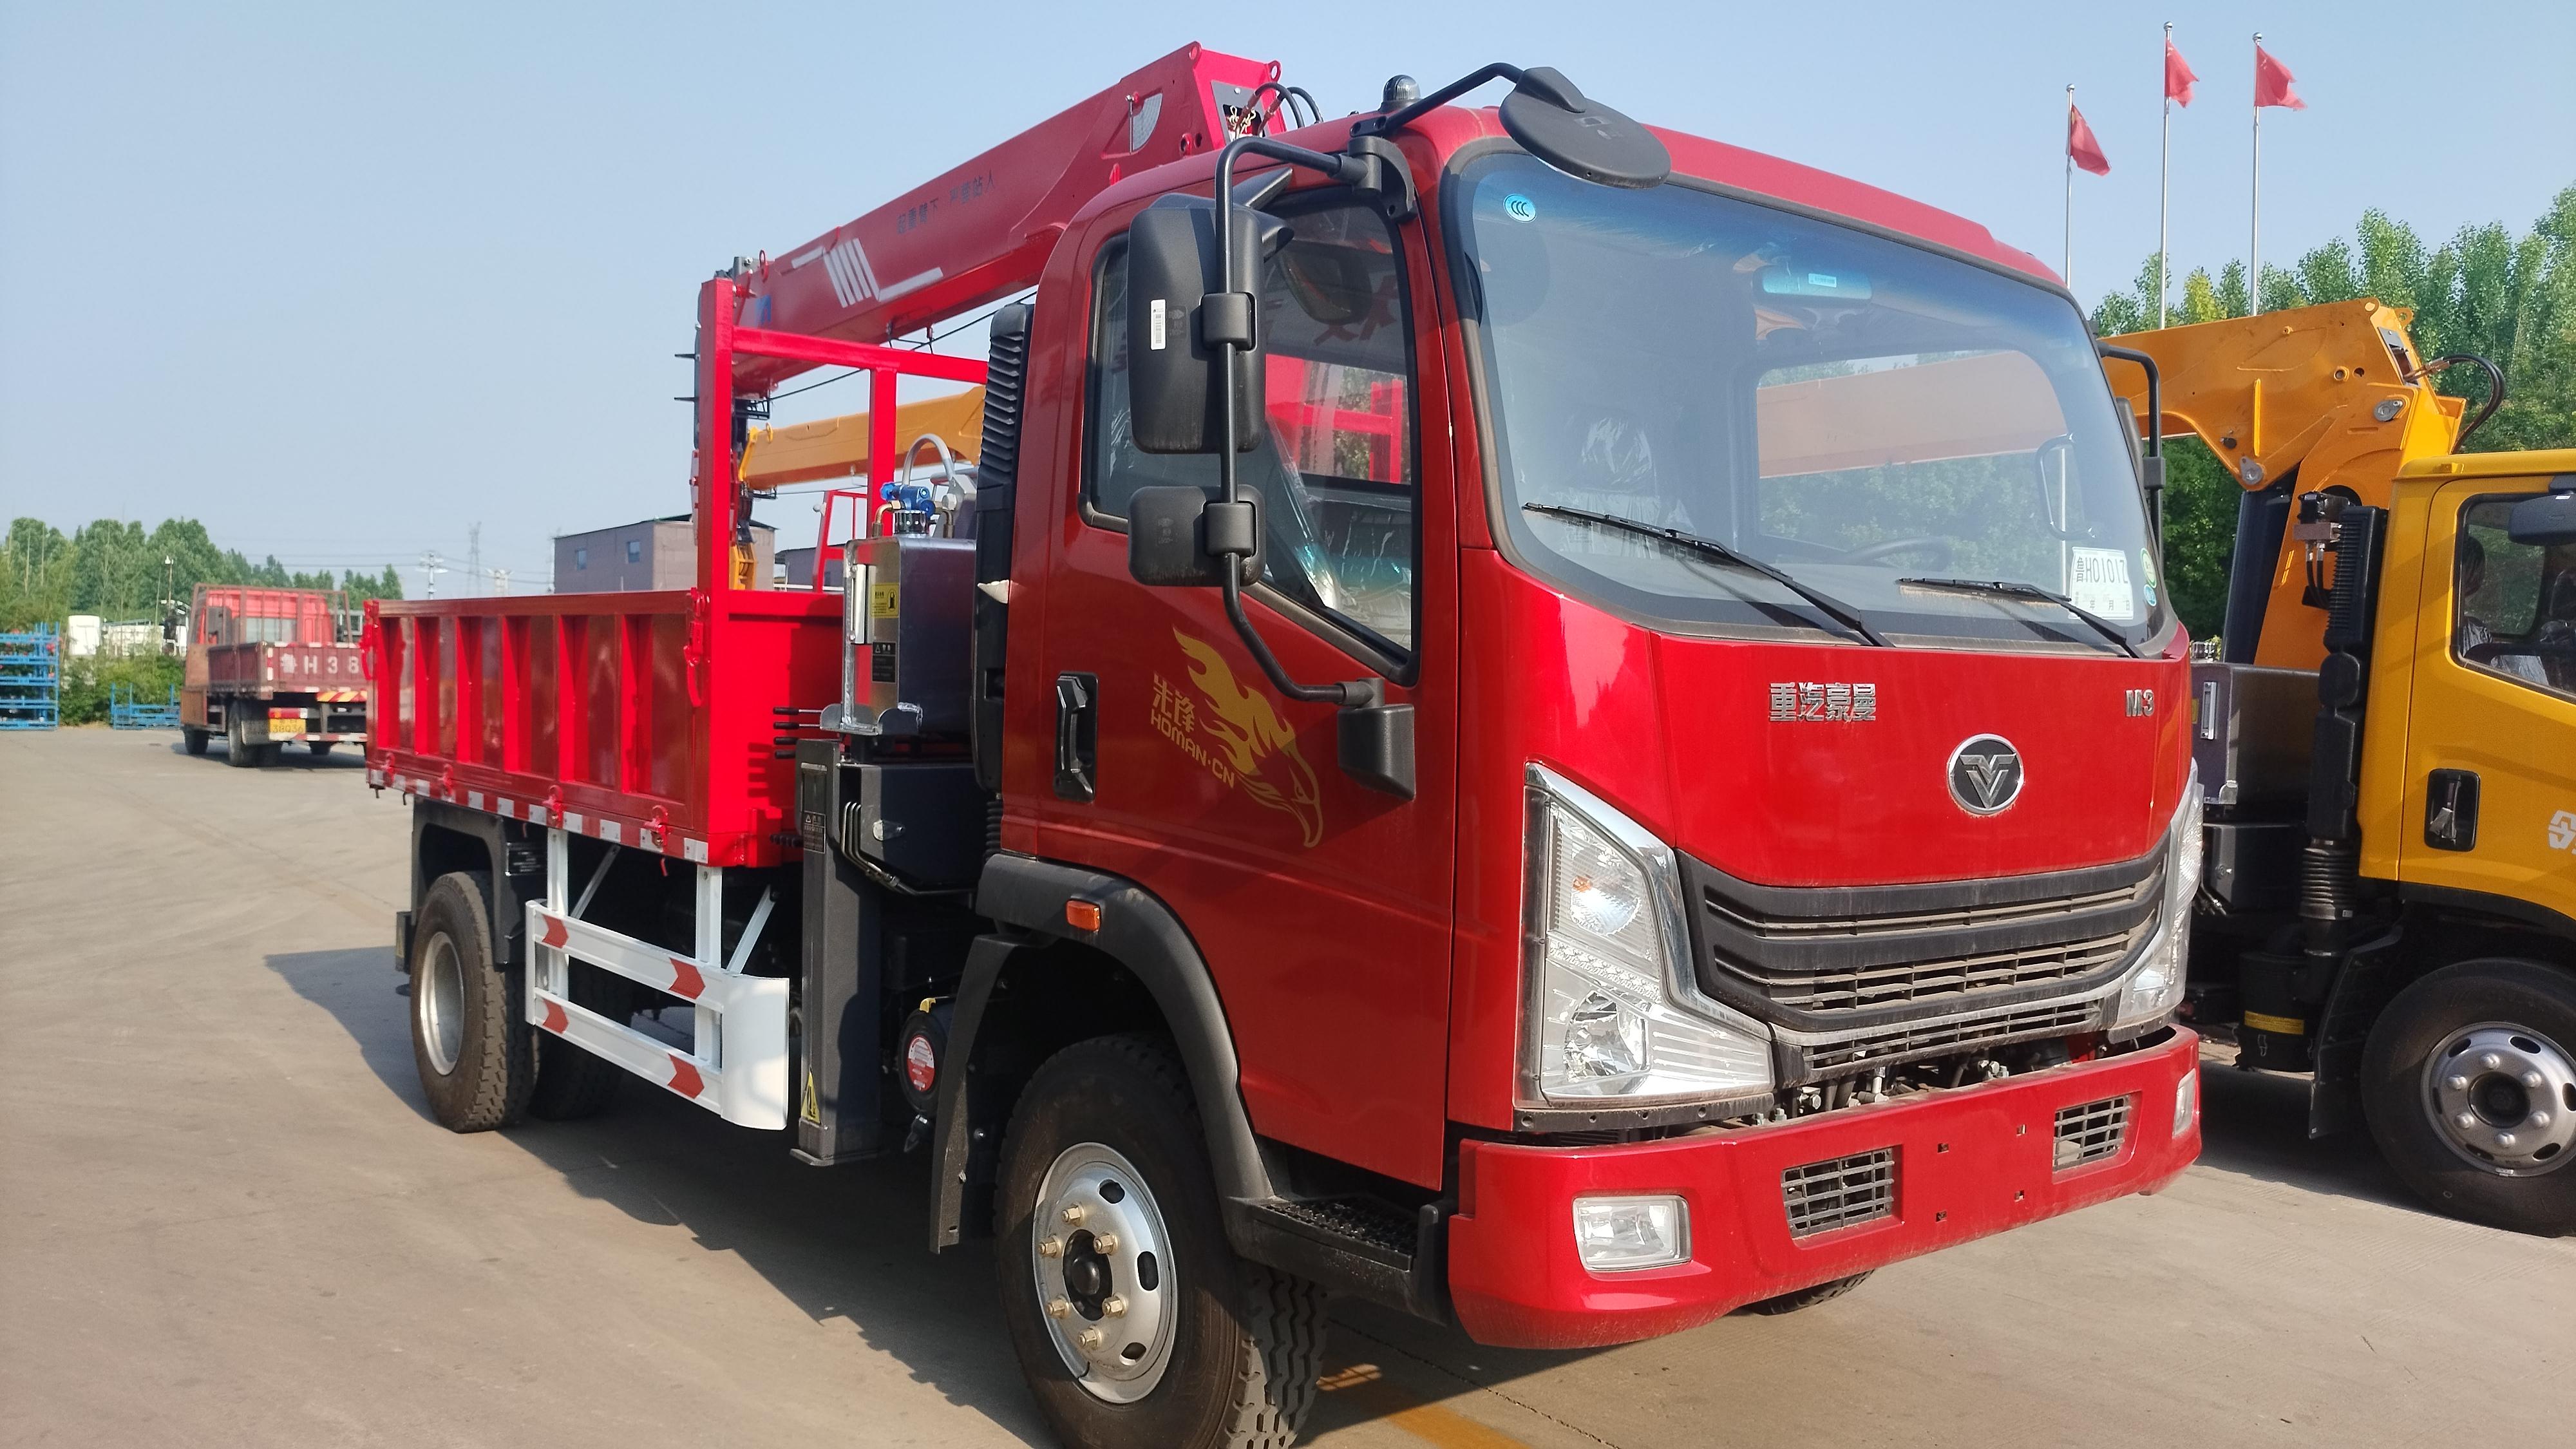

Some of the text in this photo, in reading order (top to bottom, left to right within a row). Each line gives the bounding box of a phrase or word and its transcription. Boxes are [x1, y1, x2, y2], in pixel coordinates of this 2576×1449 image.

[1769, 681, 1877, 723] 重汽豪曼
[2125, 688, 2154, 717] M3
